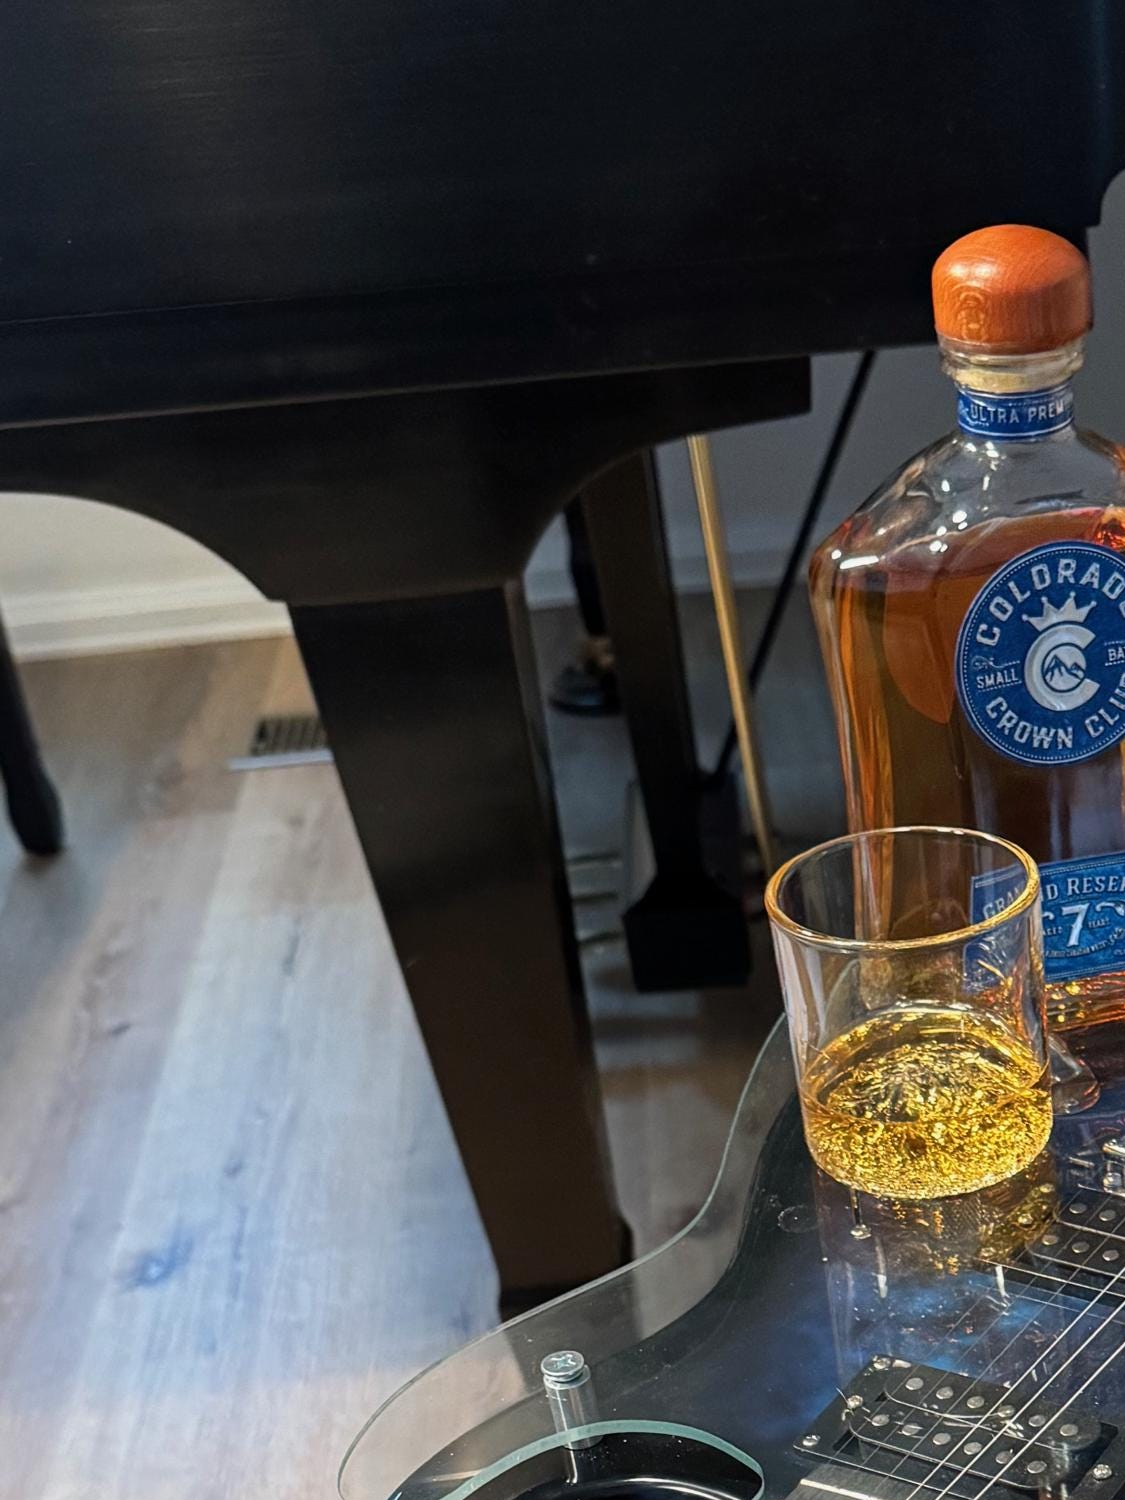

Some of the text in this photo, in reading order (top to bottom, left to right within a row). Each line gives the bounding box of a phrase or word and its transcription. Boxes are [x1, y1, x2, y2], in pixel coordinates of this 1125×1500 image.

[970, 402, 1020, 423] ULTRA
[976, 668, 1019, 689] SMALL
[985, 696, 1073, 750] CROWN
[1061, 902, 1091, 947] 7
